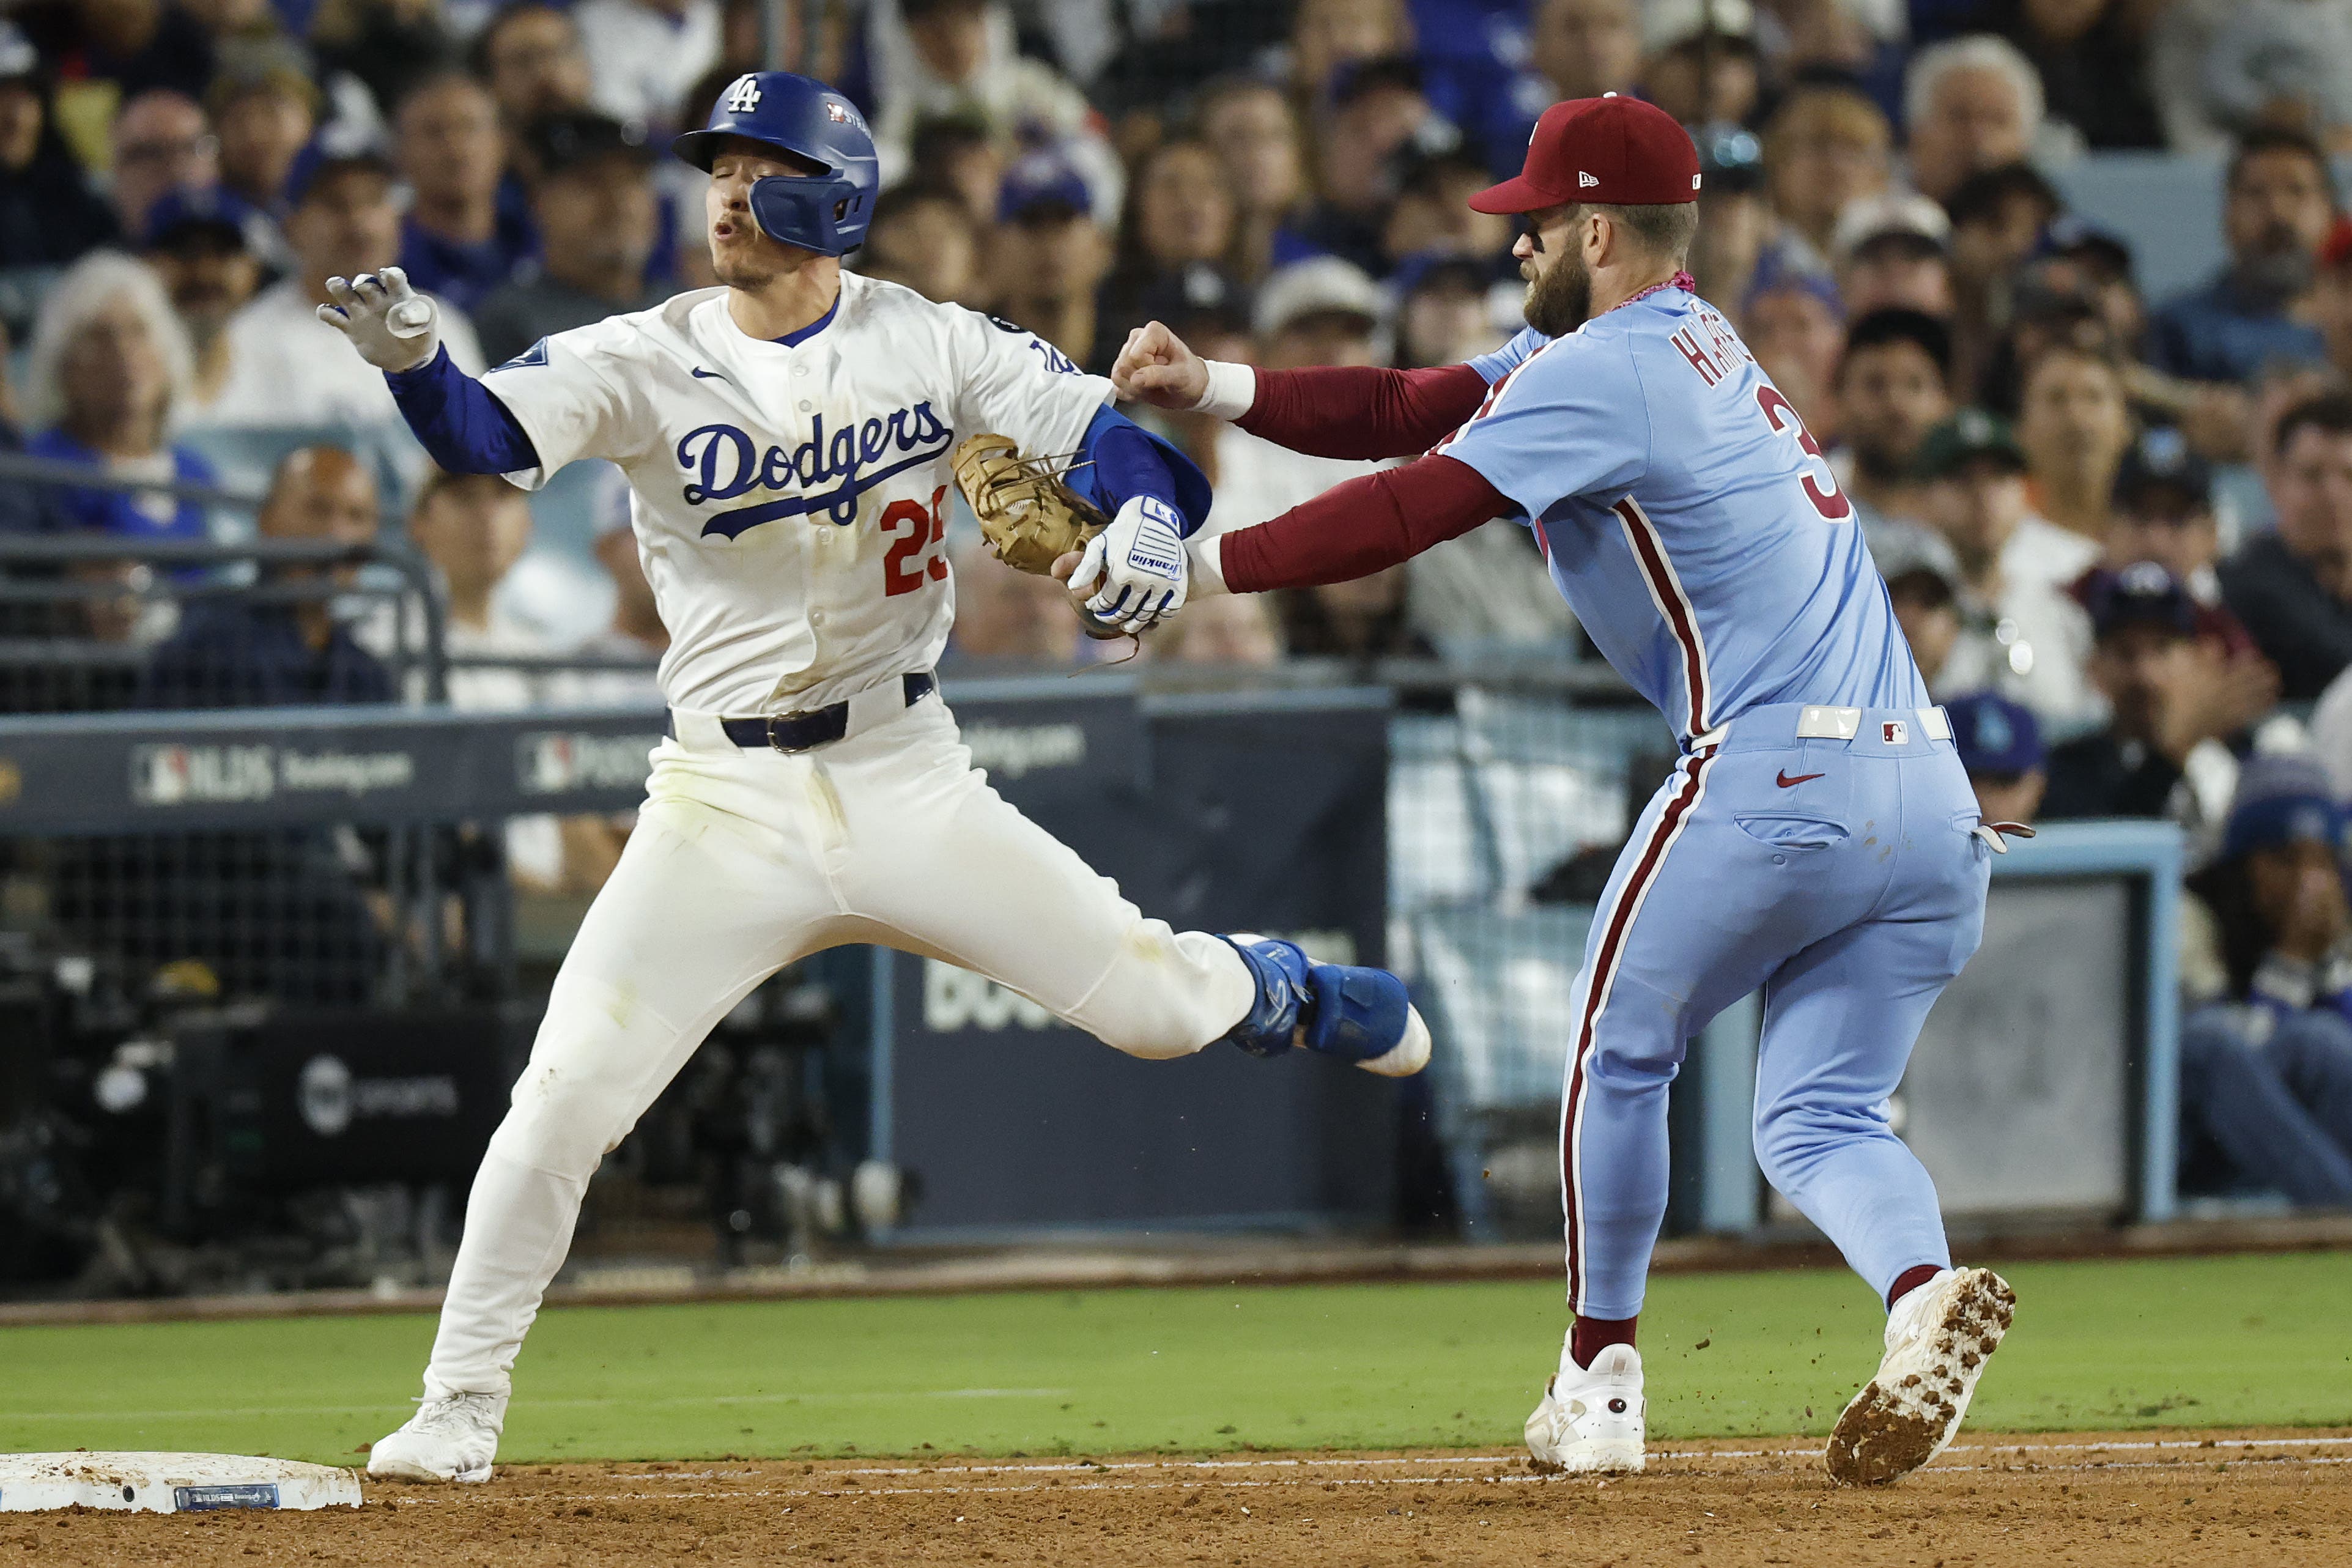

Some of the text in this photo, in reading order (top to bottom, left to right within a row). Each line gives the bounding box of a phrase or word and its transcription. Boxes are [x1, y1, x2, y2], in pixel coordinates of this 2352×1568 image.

[728, 73, 762, 113] LA
[677, 400, 954, 532] Dodgers
[1752, 380, 1854, 524] 3
